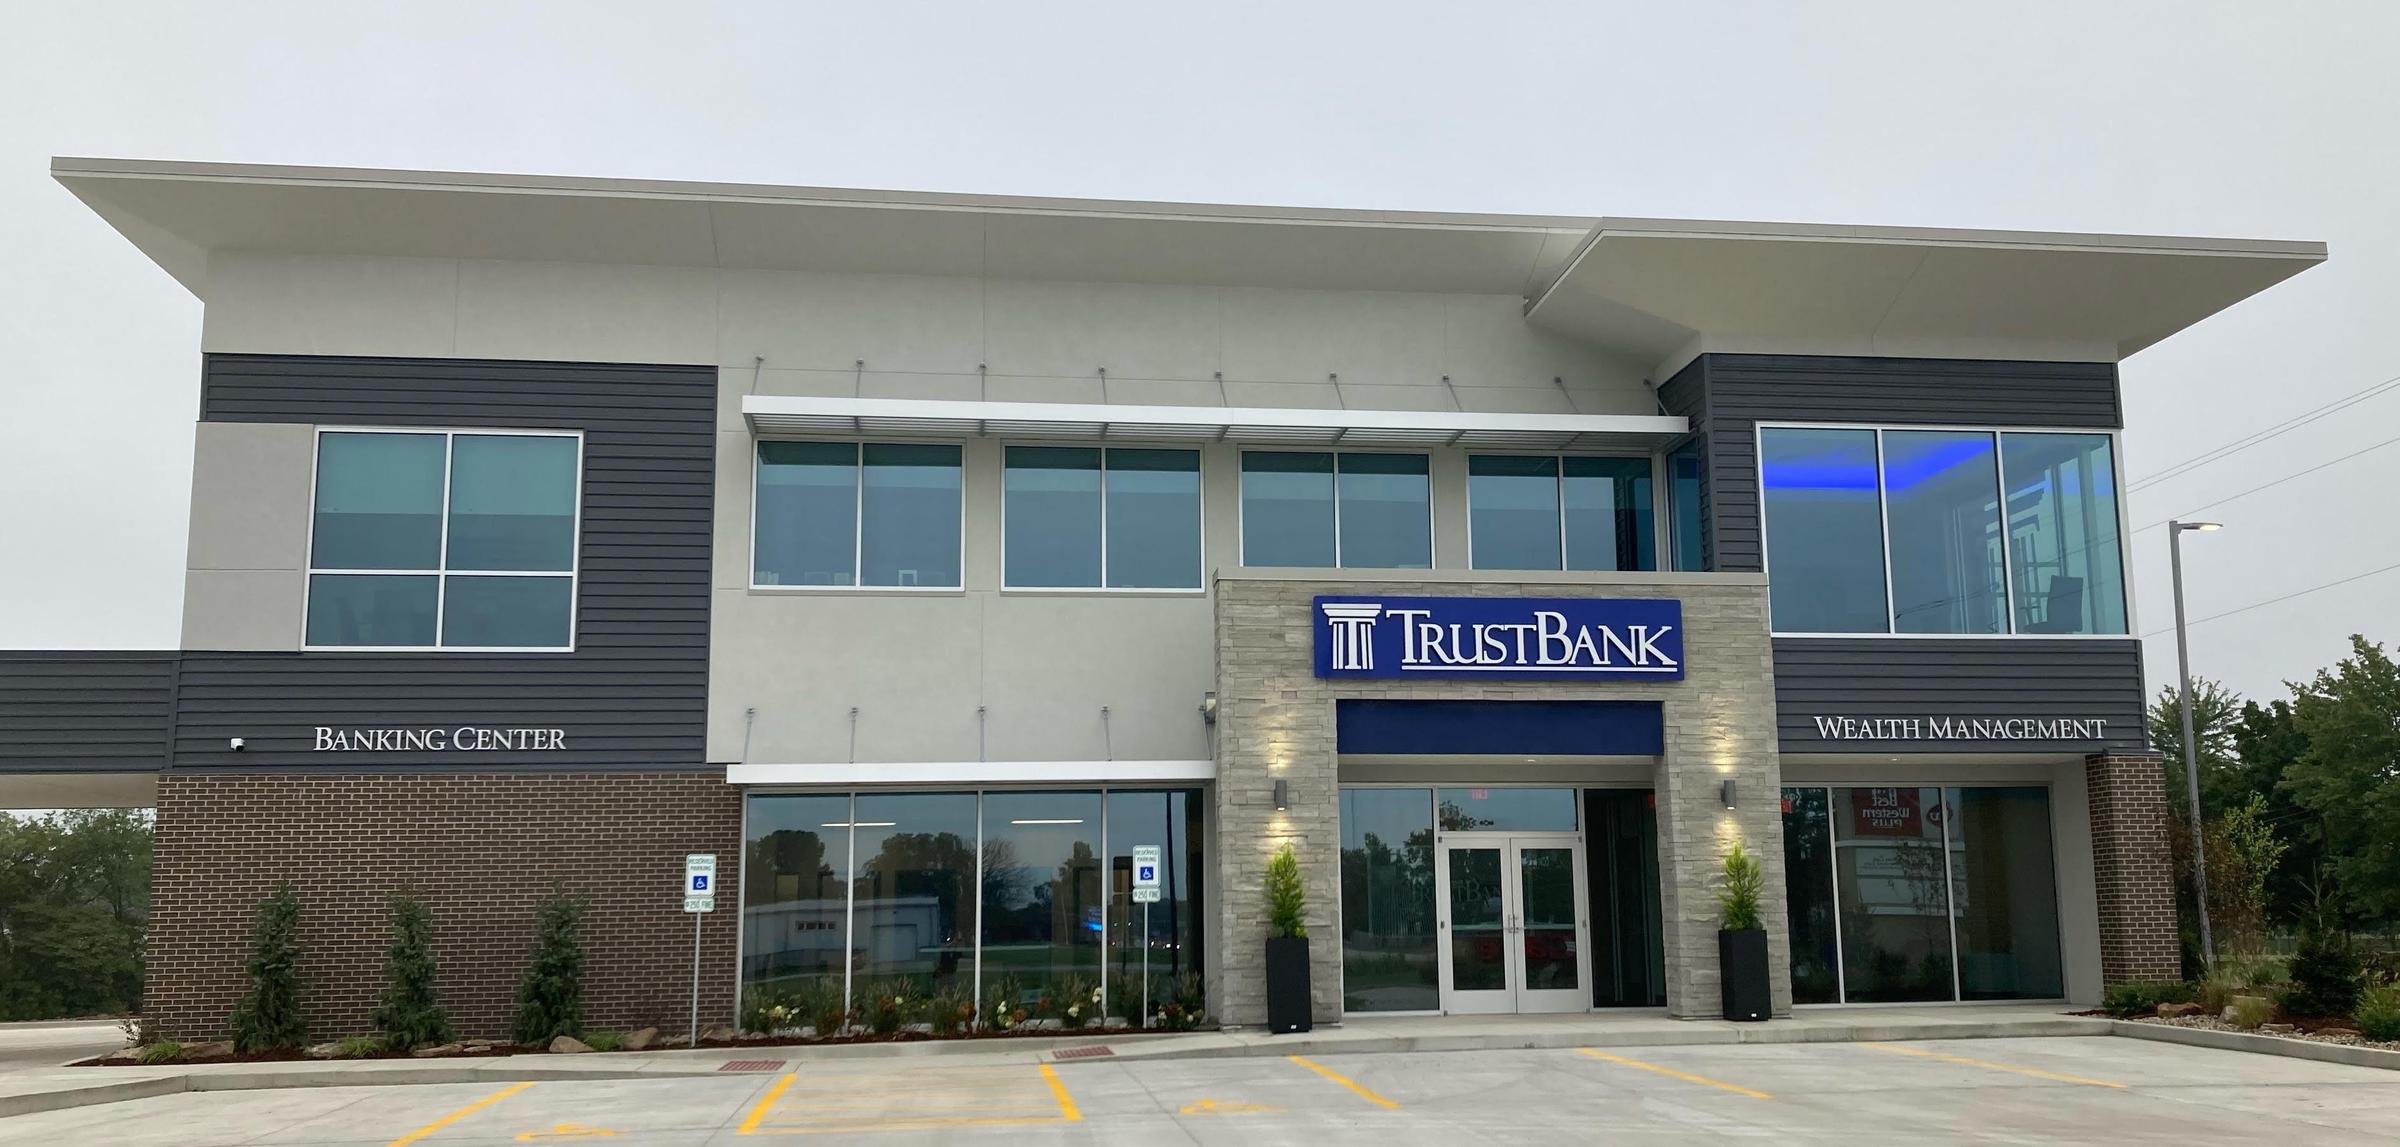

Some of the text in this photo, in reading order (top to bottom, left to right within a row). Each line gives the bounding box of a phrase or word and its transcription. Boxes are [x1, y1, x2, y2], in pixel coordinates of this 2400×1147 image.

[313, 726, 567, 751] BANKING CENTER
[1813, 716, 2107, 740] WEALTH MANAGEMENT
